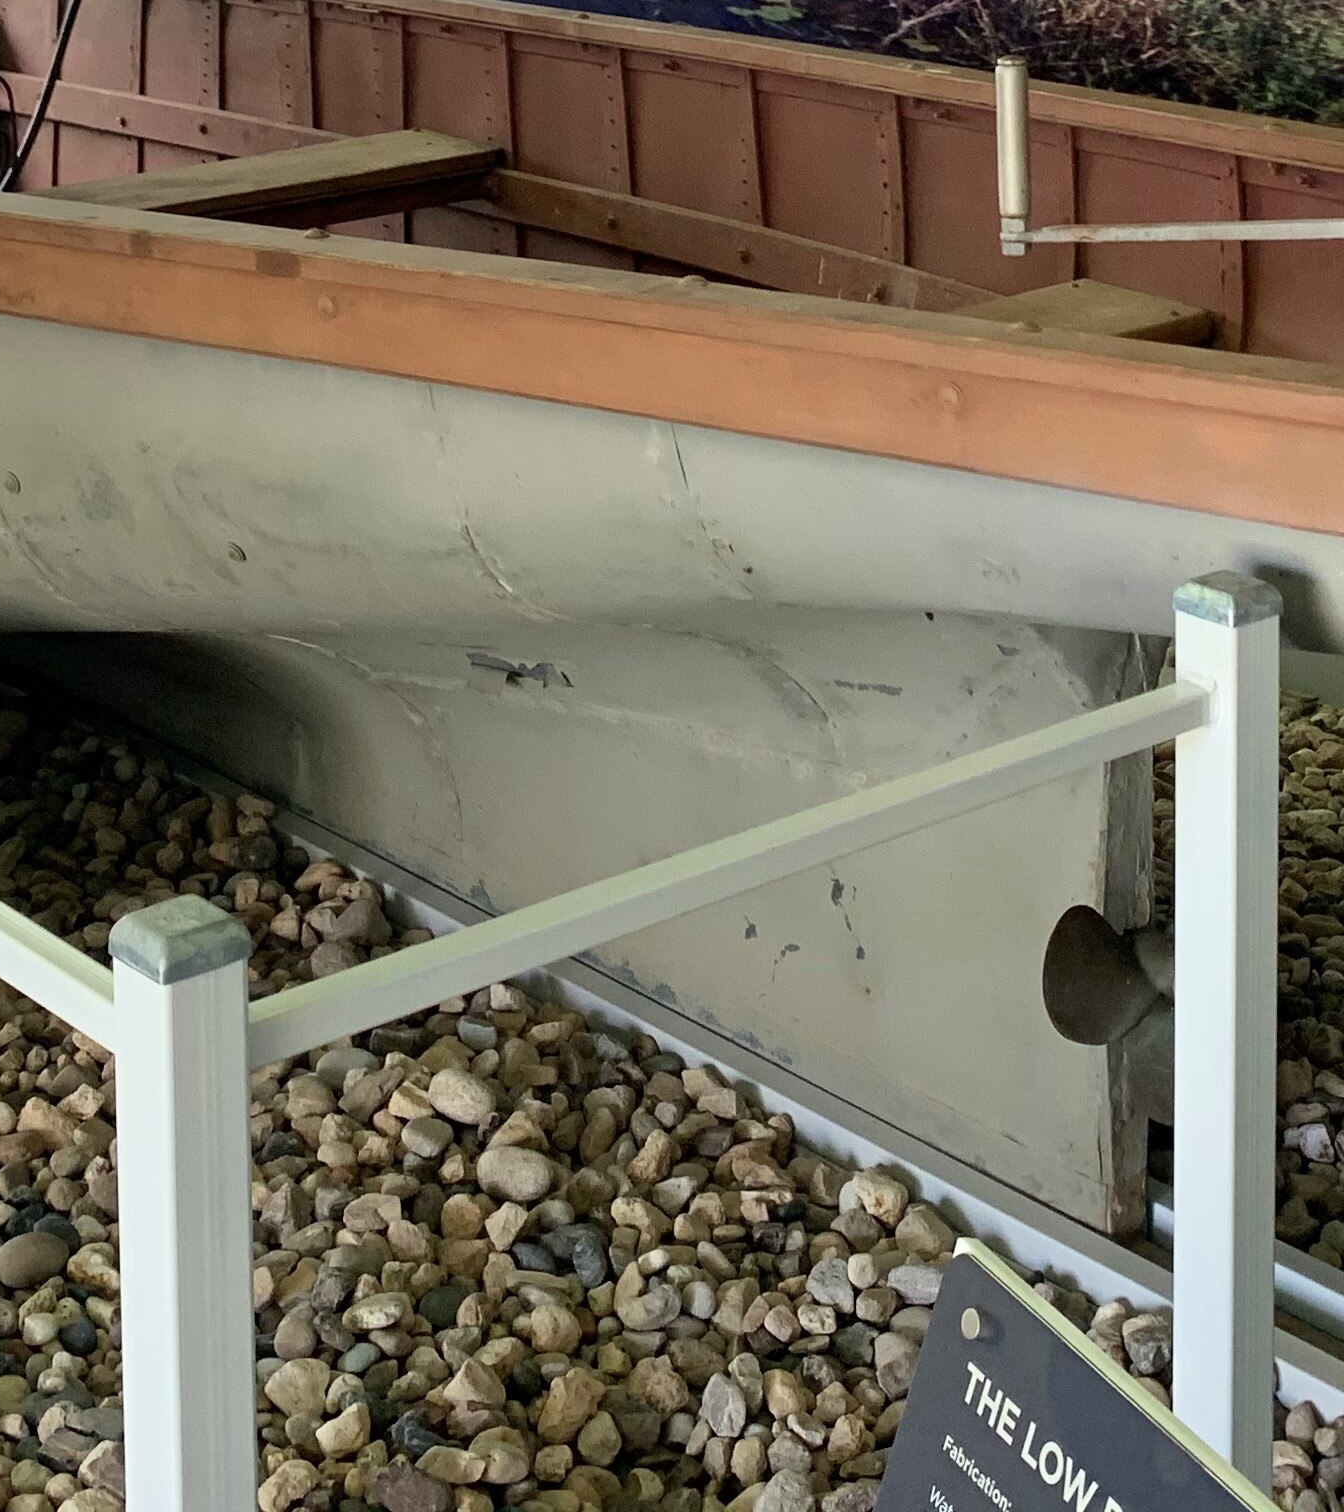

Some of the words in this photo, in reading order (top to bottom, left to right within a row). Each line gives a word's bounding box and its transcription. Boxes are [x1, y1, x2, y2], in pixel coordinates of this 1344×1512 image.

[942, 1434, 1013, 1512] Fabrication:
[964, 1361, 1021, 1446] THE
[1021, 1420, 1100, 1512] LOW
